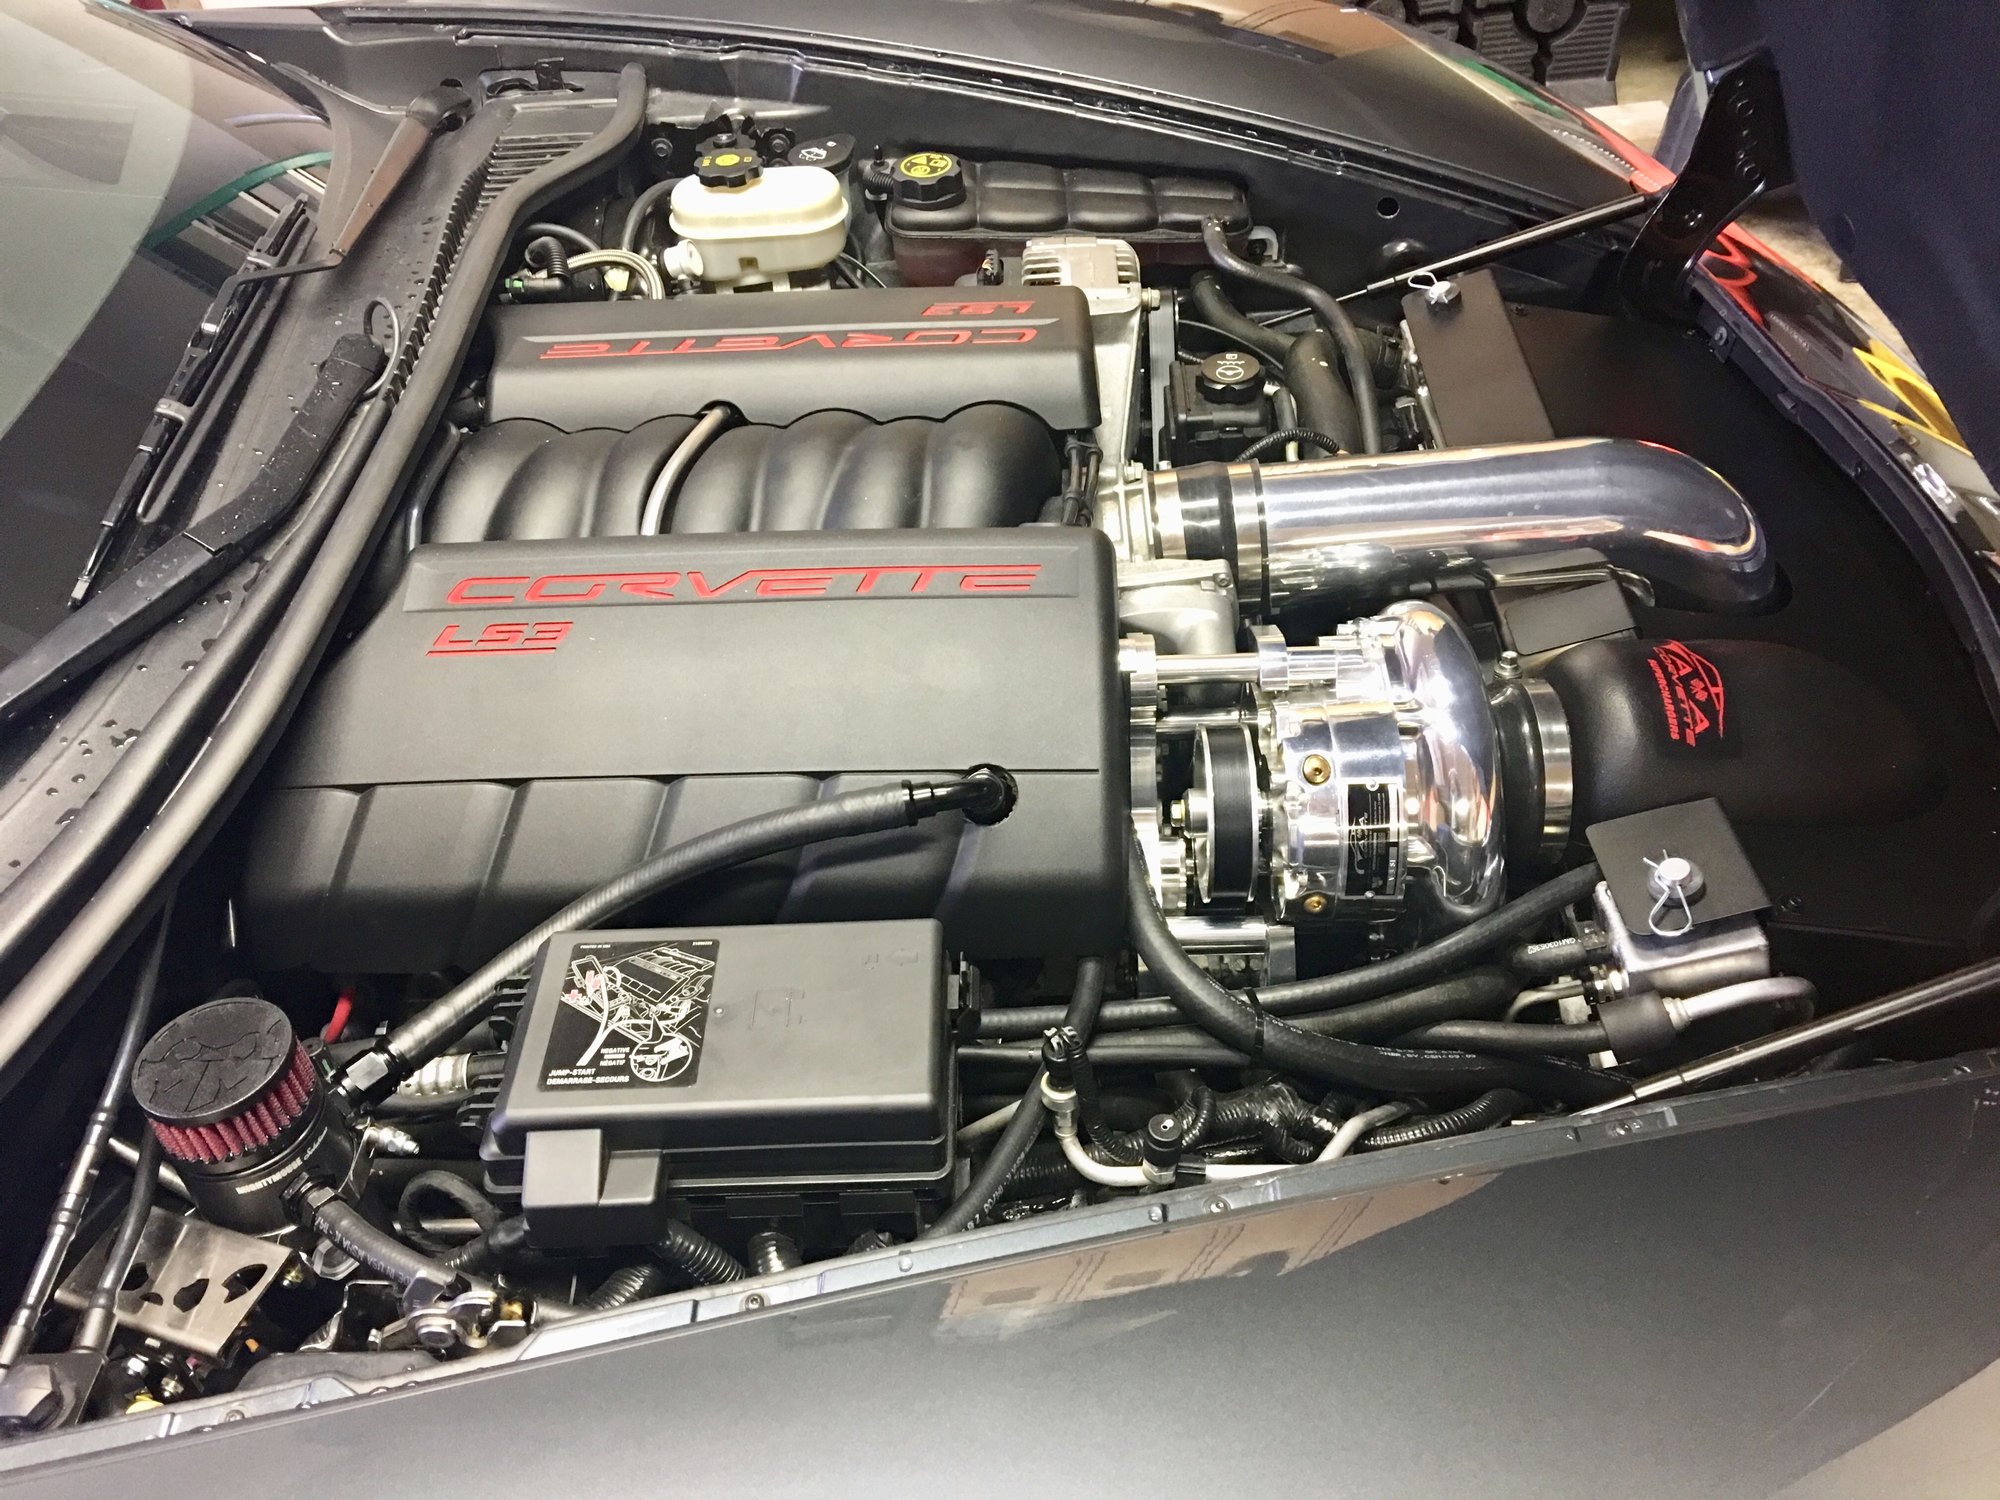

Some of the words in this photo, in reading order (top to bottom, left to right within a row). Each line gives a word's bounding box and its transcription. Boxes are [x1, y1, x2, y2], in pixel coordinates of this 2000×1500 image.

[920, 301, 1036, 317] LS3
[537, 327, 1039, 359] CORVETTE
[446, 564, 1042, 605] CORVETTE
[432, 620, 575, 648] LS3
[1647, 659, 1680, 740] SUPERCHARGERS
[1653, 646, 1696, 747] CORVETTE
[549, 1068, 596, 1076] JUMP-START
[235, 1156, 303, 1195] MIGHTYMOUSE
[367, 1255, 386, 1272] USA
